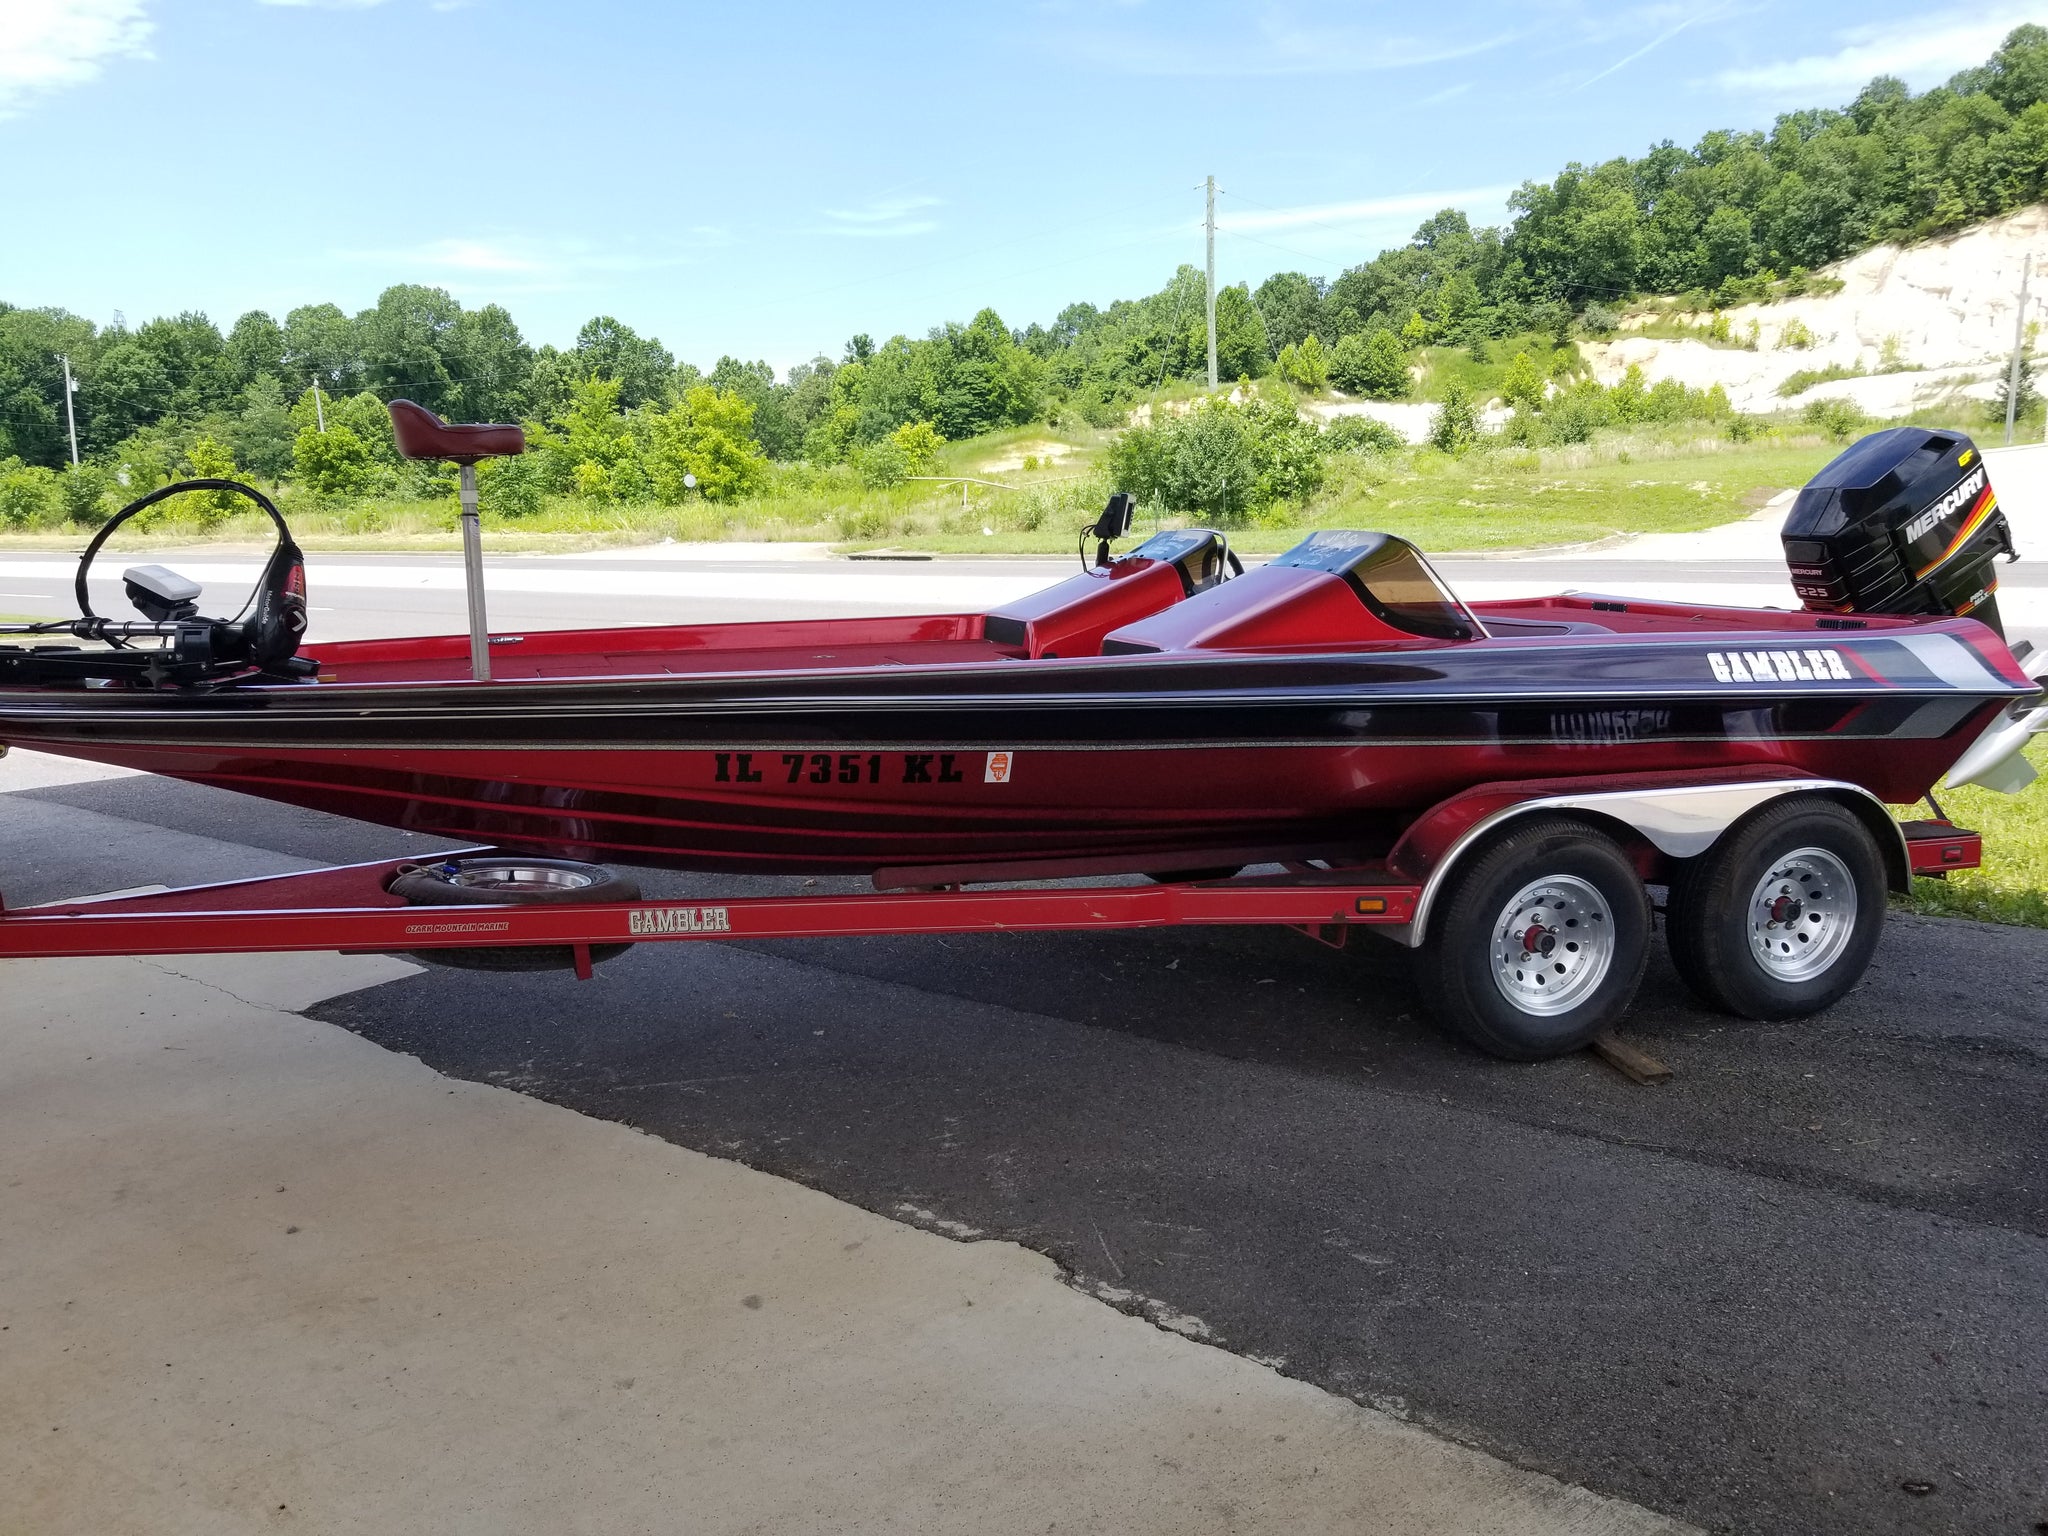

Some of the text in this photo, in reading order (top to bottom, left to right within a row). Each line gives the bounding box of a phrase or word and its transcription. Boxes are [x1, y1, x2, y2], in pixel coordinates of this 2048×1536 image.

[1905, 467, 1984, 545] MERCURY
[1791, 568, 1823, 576] MERCURY
[1796, 586, 1829, 597] 225
[1706, 650, 1852, 683] GAMBLER
[714, 753, 762, 783] IL
[782, 754, 881, 784] 7351
[902, 754, 963, 784] KL
[406, 922, 509, 934] OZARK MOUNTAIN MARINE
[629, 907, 731, 934] GAMBLER
